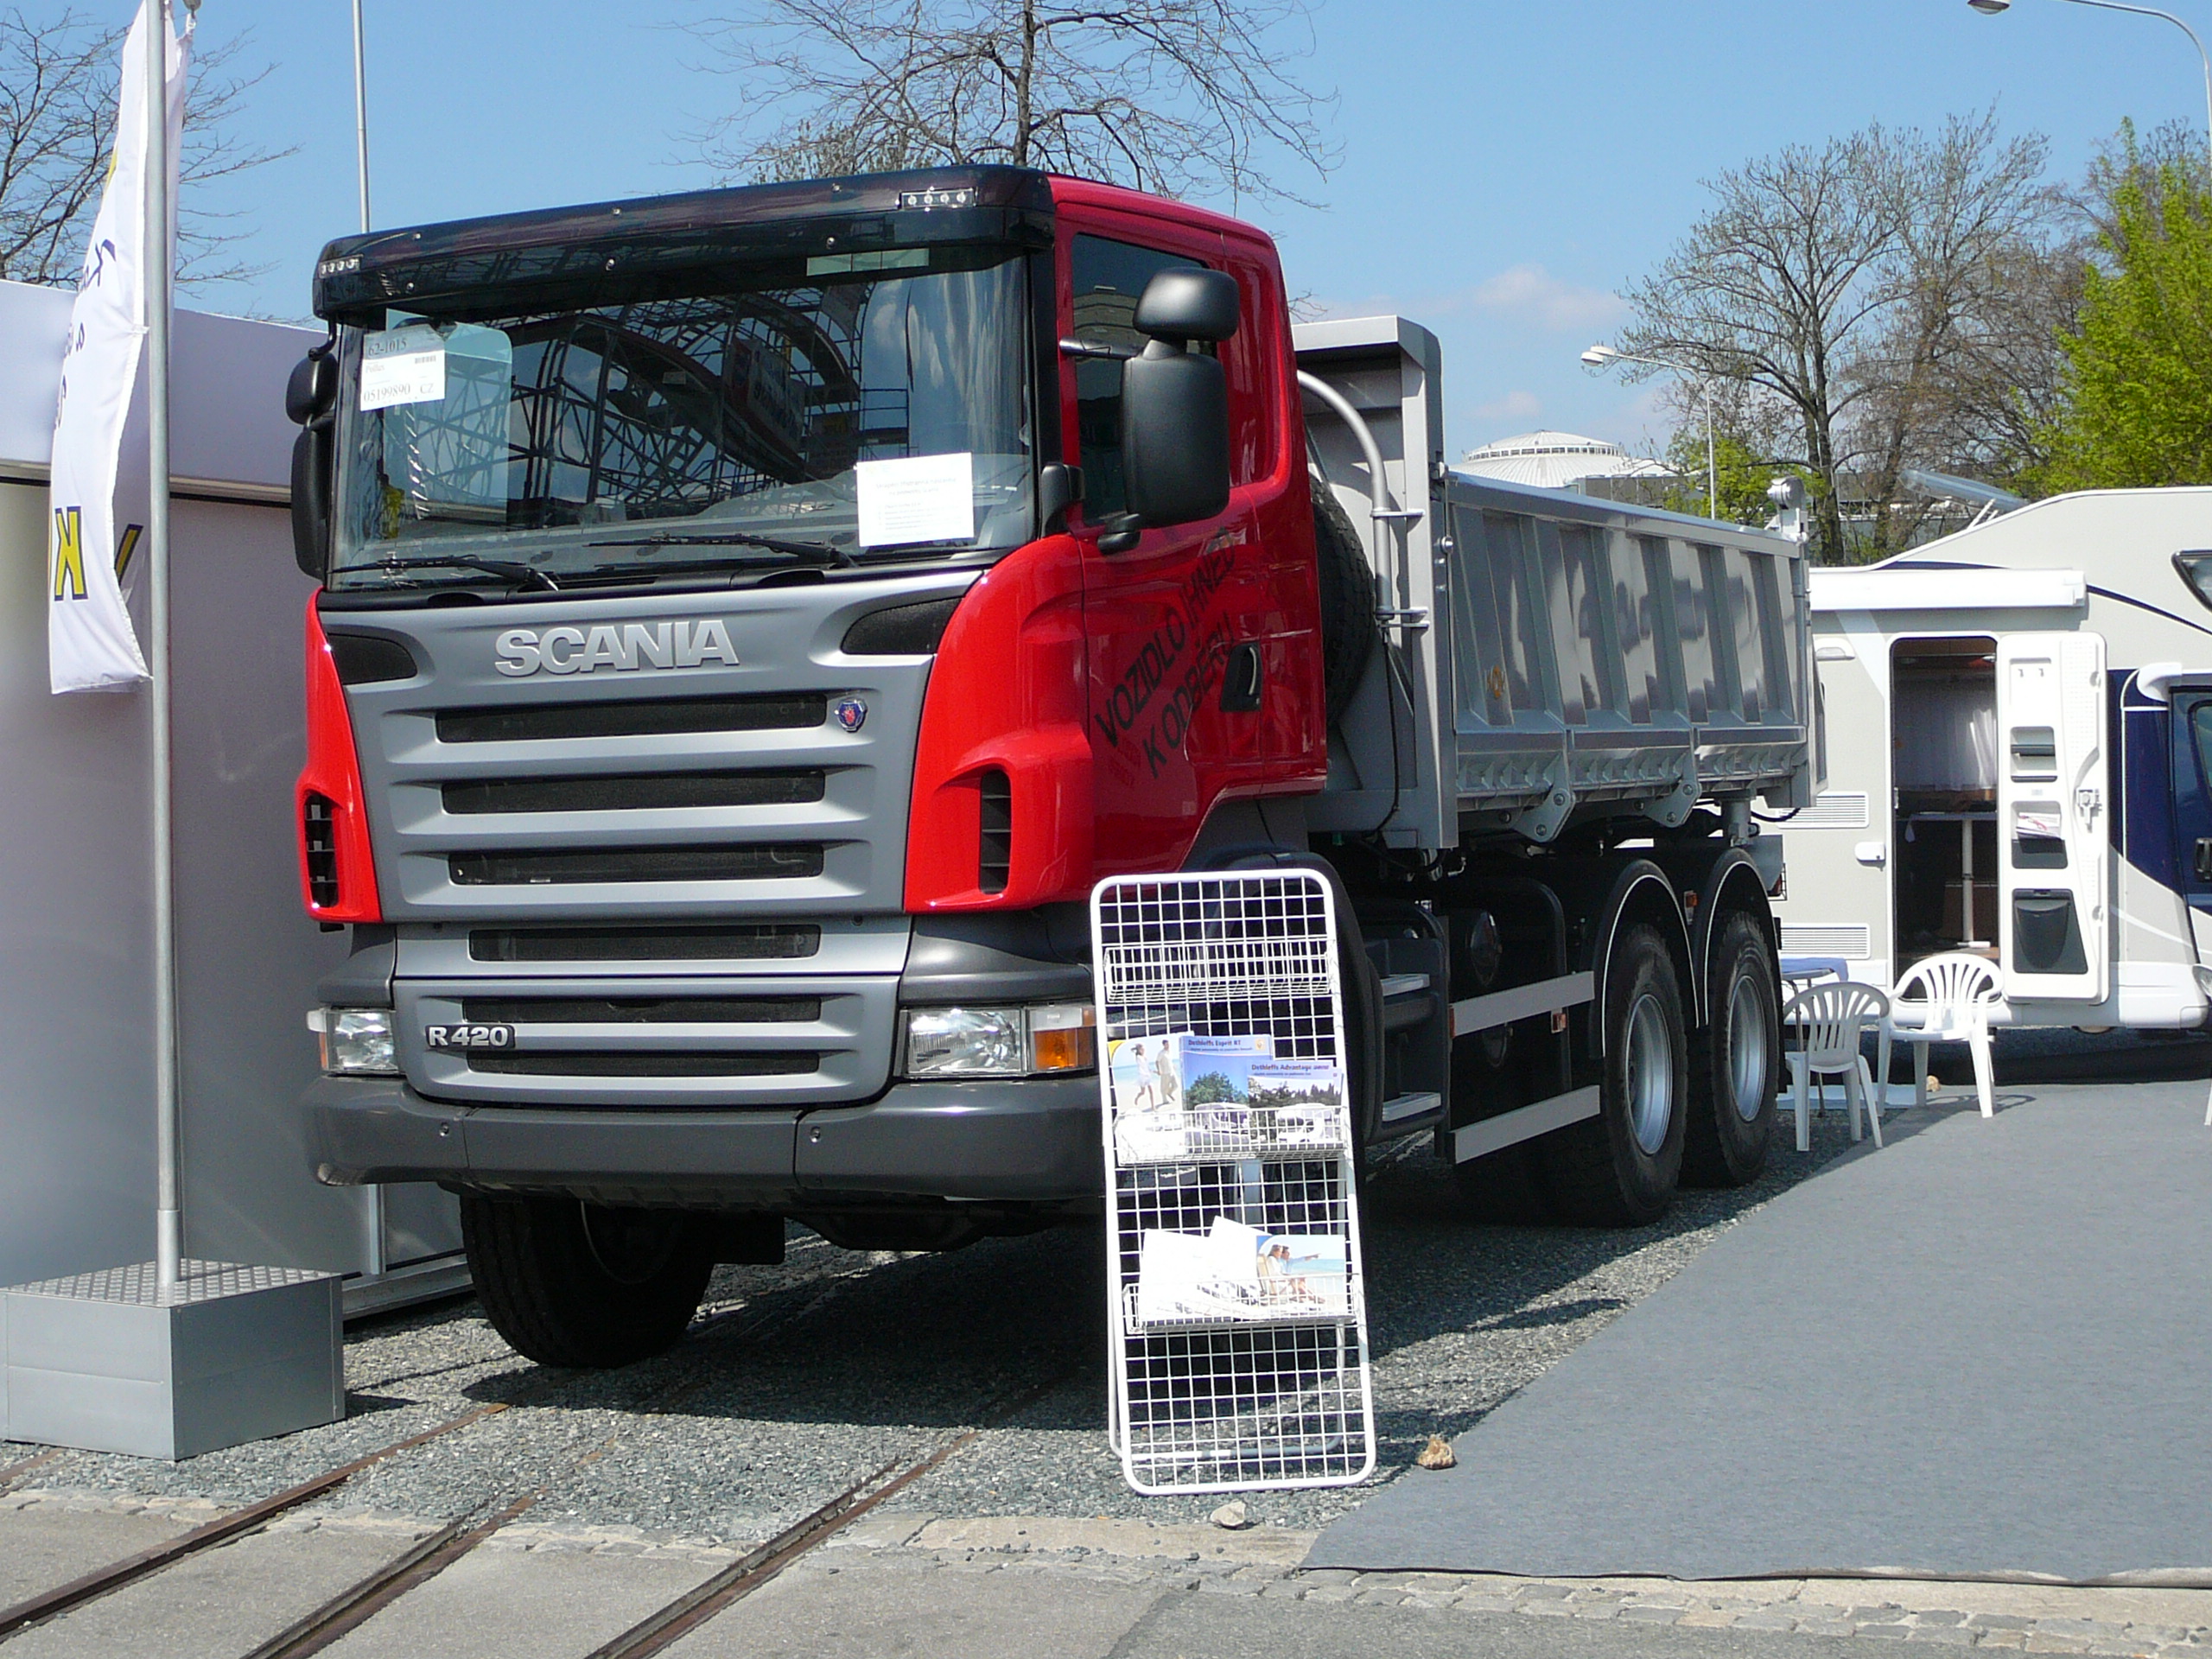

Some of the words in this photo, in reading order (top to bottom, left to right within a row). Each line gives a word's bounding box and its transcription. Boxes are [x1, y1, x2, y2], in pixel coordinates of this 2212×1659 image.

[364, 383, 410, 403] 05199890
[420, 383, 435, 394] CZ
[495, 620, 740, 677] SCANIA
[1095, 607, 1185, 747] VOZIDLO
[1142, 725, 1166, 778] K
[429, 1027, 448, 1046] R
[451, 1027, 508, 1046] 420
